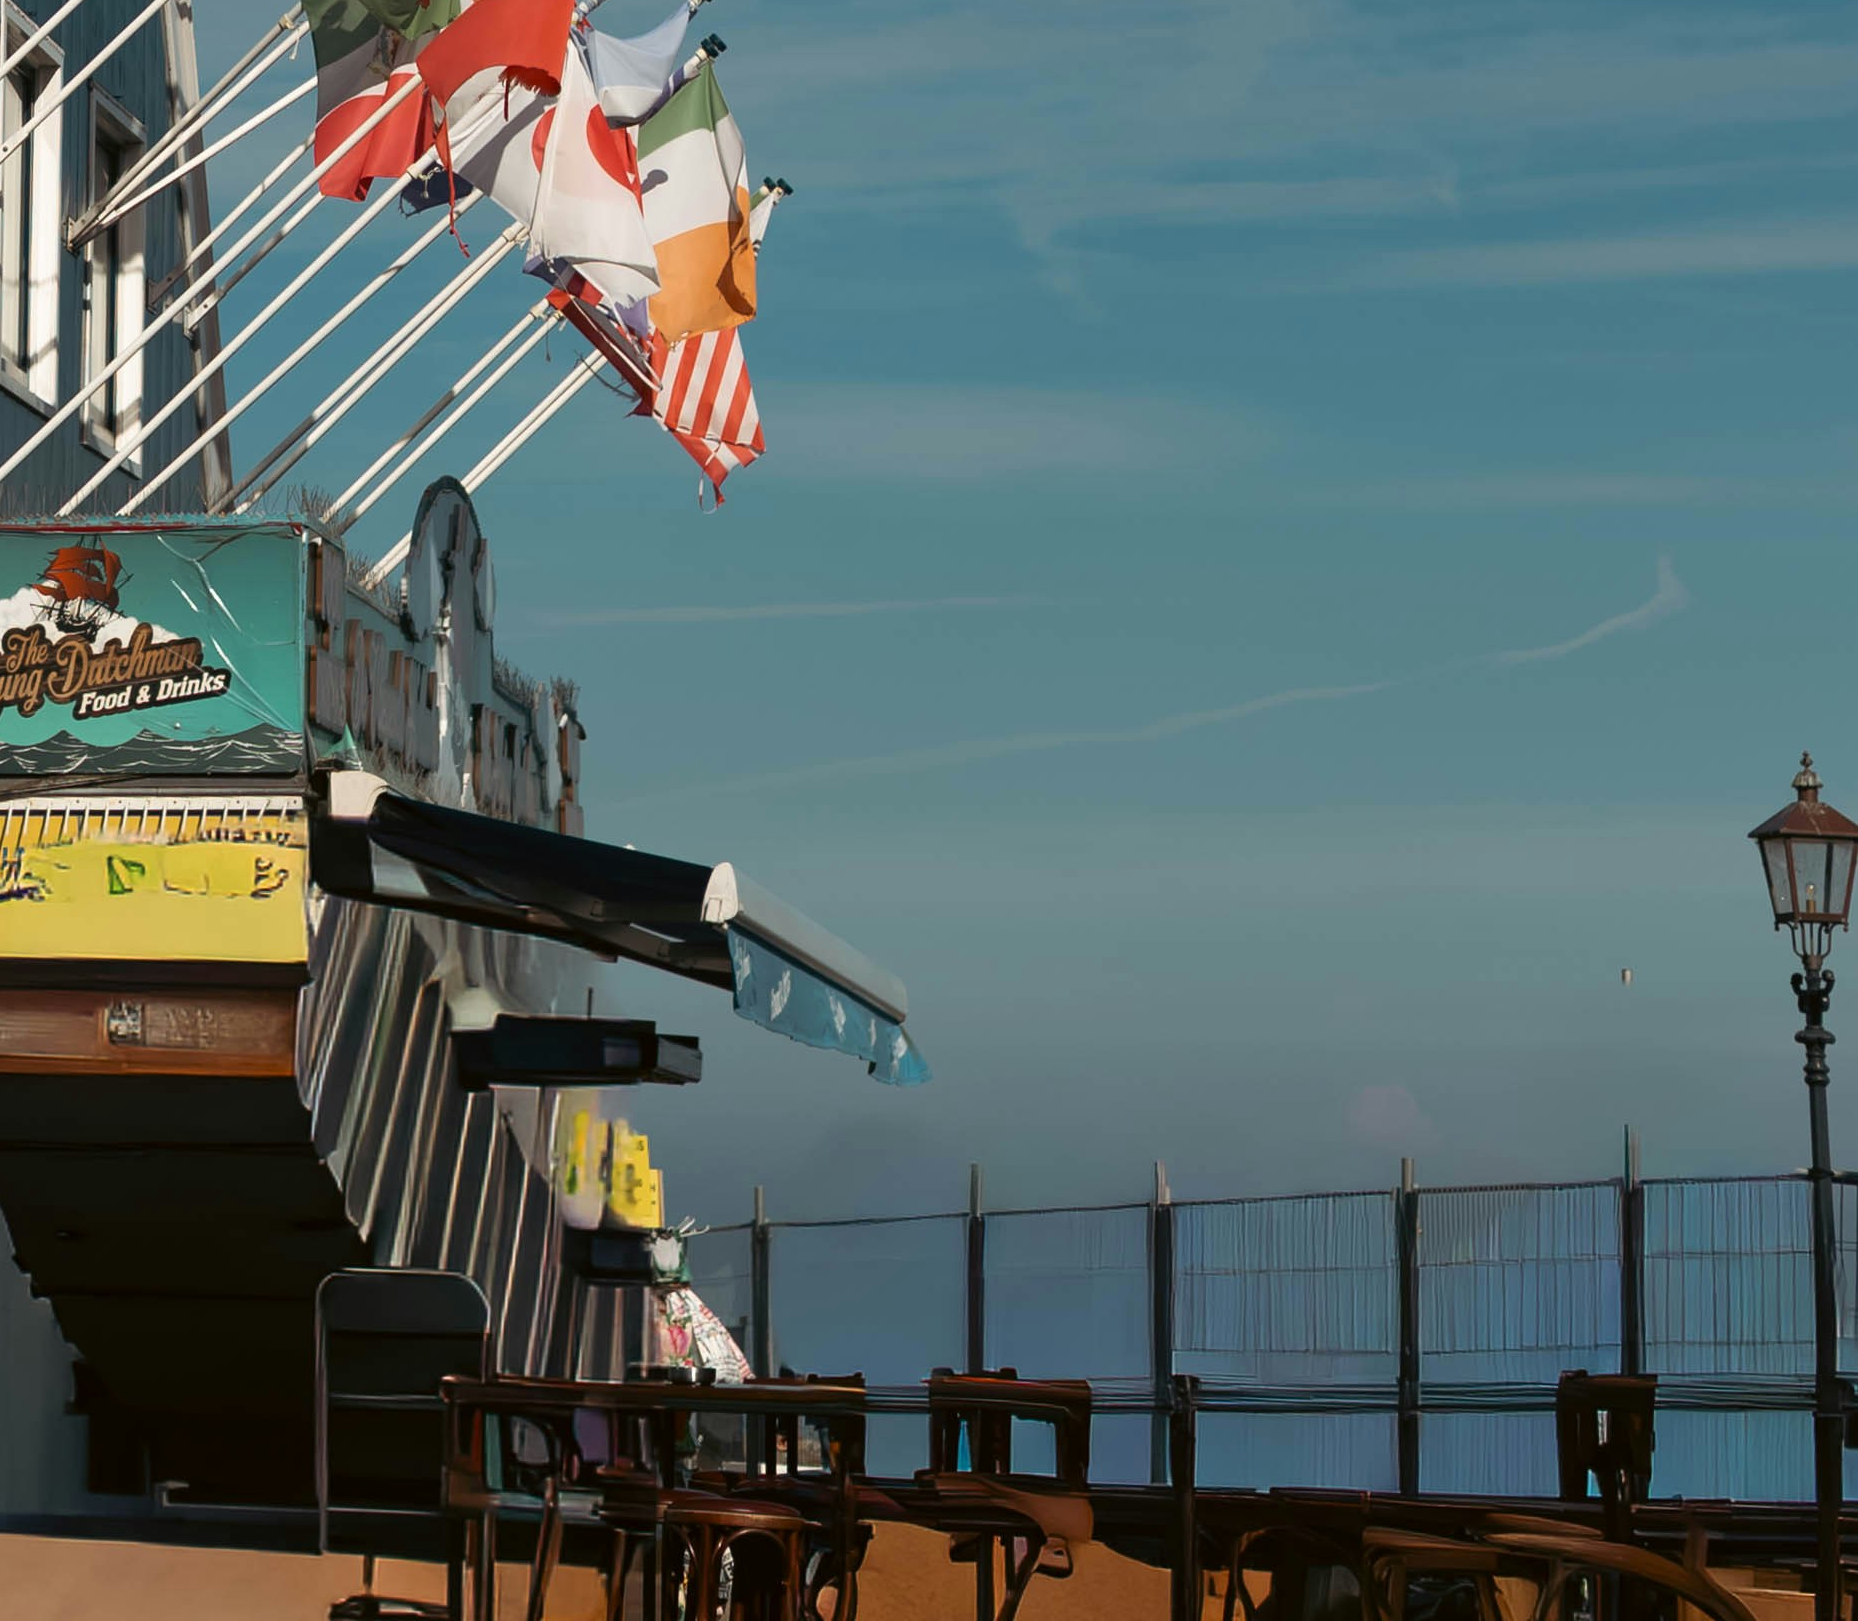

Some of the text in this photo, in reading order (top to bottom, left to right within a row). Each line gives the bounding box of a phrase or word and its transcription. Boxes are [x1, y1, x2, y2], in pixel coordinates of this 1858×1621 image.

[7, 629, 50, 673] The
[46, 633, 199, 699] Dutchman
[78, 671, 226, 715] Food & Drinks
